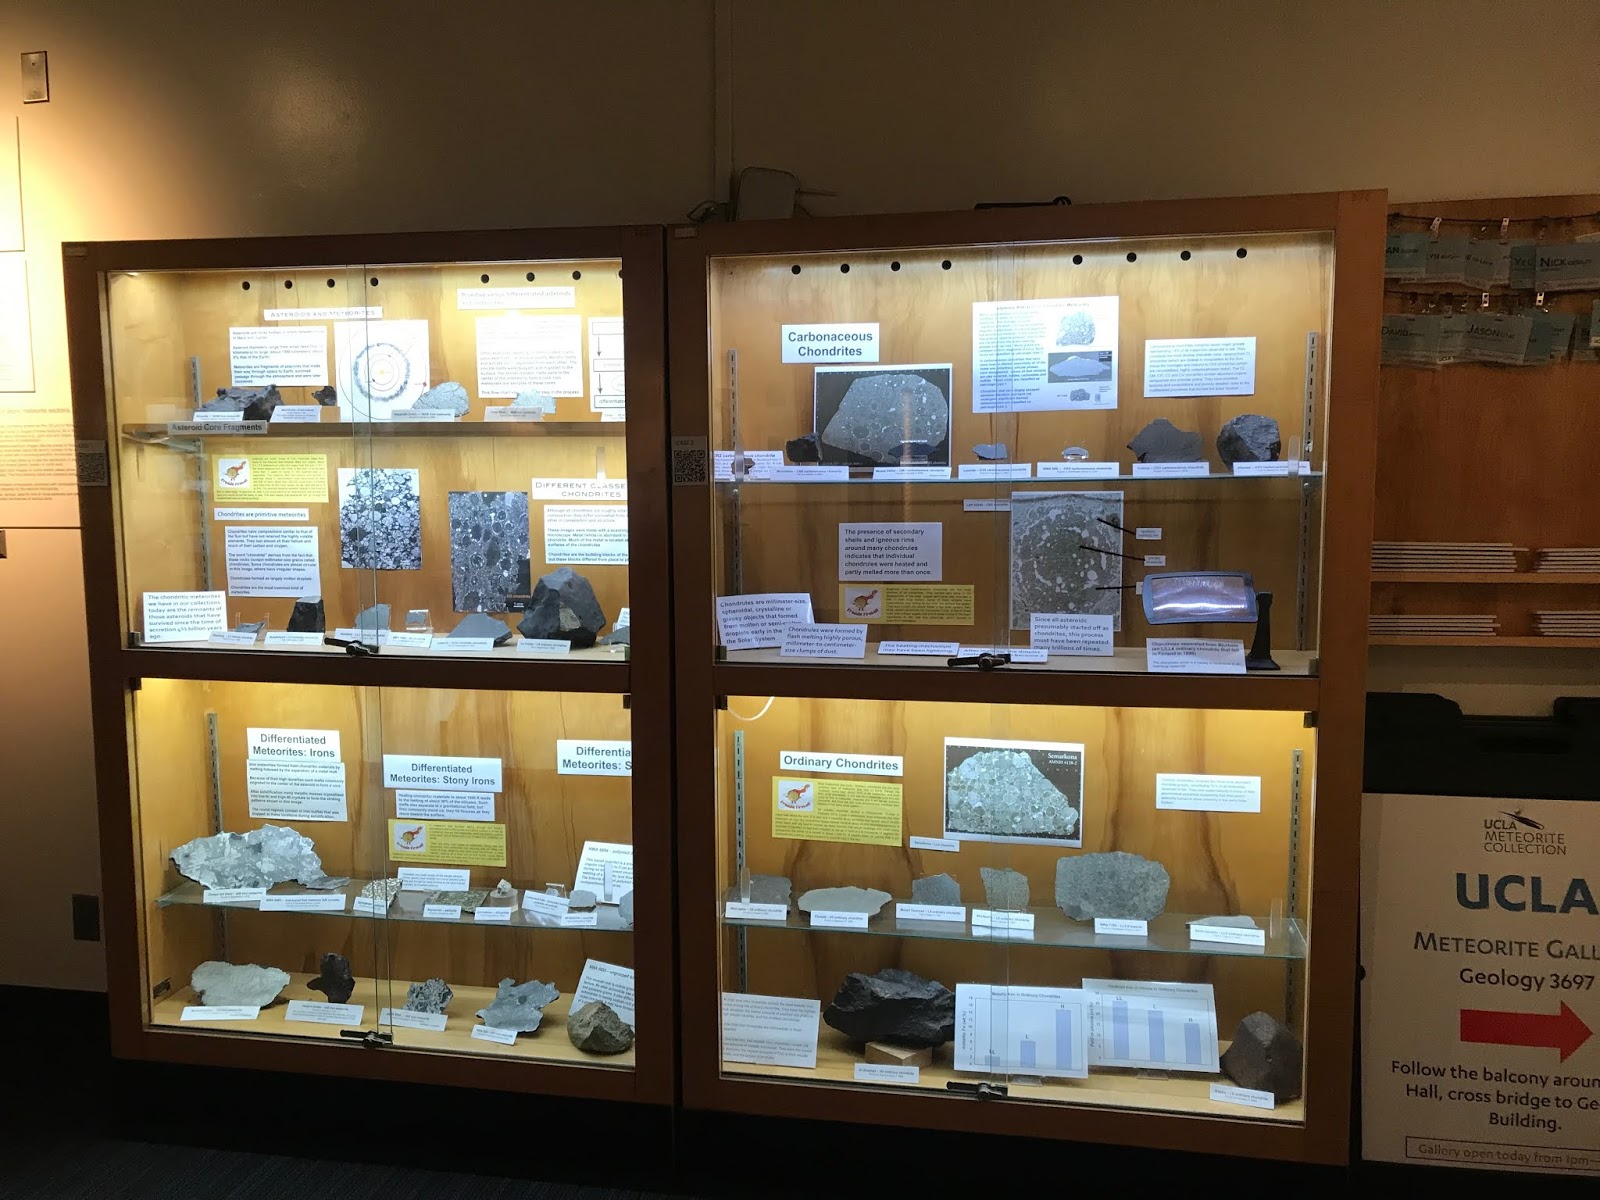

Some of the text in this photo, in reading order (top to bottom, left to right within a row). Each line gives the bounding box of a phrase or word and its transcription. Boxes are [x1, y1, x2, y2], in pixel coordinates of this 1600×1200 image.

[1381, 326, 1408, 336] DAVID
[1467, 325, 1500, 336] JASON
[788, 332, 872, 342] Carbonaceous
[798, 346, 862, 356] Chondrites
[261, 734, 326, 744] Differentiated
[253, 746, 335, 757] Meteorites: Irons
[576, 747, 630, 757] Differentia
[412, 764, 472, 773] Differentiated
[563, 759, 621, 770] Meteorites:
[784, 755, 899, 770] Ordinary Chondrites
[390, 774, 495, 786] Meteorites: Stony Irons
[1484, 820, 1517, 830] UCLA
[1485, 831, 1565, 844] METEORITE
[1484, 842, 1567, 855] COLLECTION
[1456, 873, 1599, 915] UCLA
[1414, 932, 1539, 957] METEORITE
[1460, 968, 1594, 991] Geology 3697
[1392, 1061, 1446, 1077] Follow
[1450, 1065, 1478, 1080] the
[1483, 1067, 1548, 1088] balcony
[1406, 1084, 1443, 1102] Hall,
[1448, 1090, 1491, 1103] cross
[1496, 1091, 1550, 1110] bridge
[1555, 1097, 1572, 1109] to
[1489, 1113, 1562, 1132] Building.
[1419, 1144, 1562, 1164] Gallery open today from
